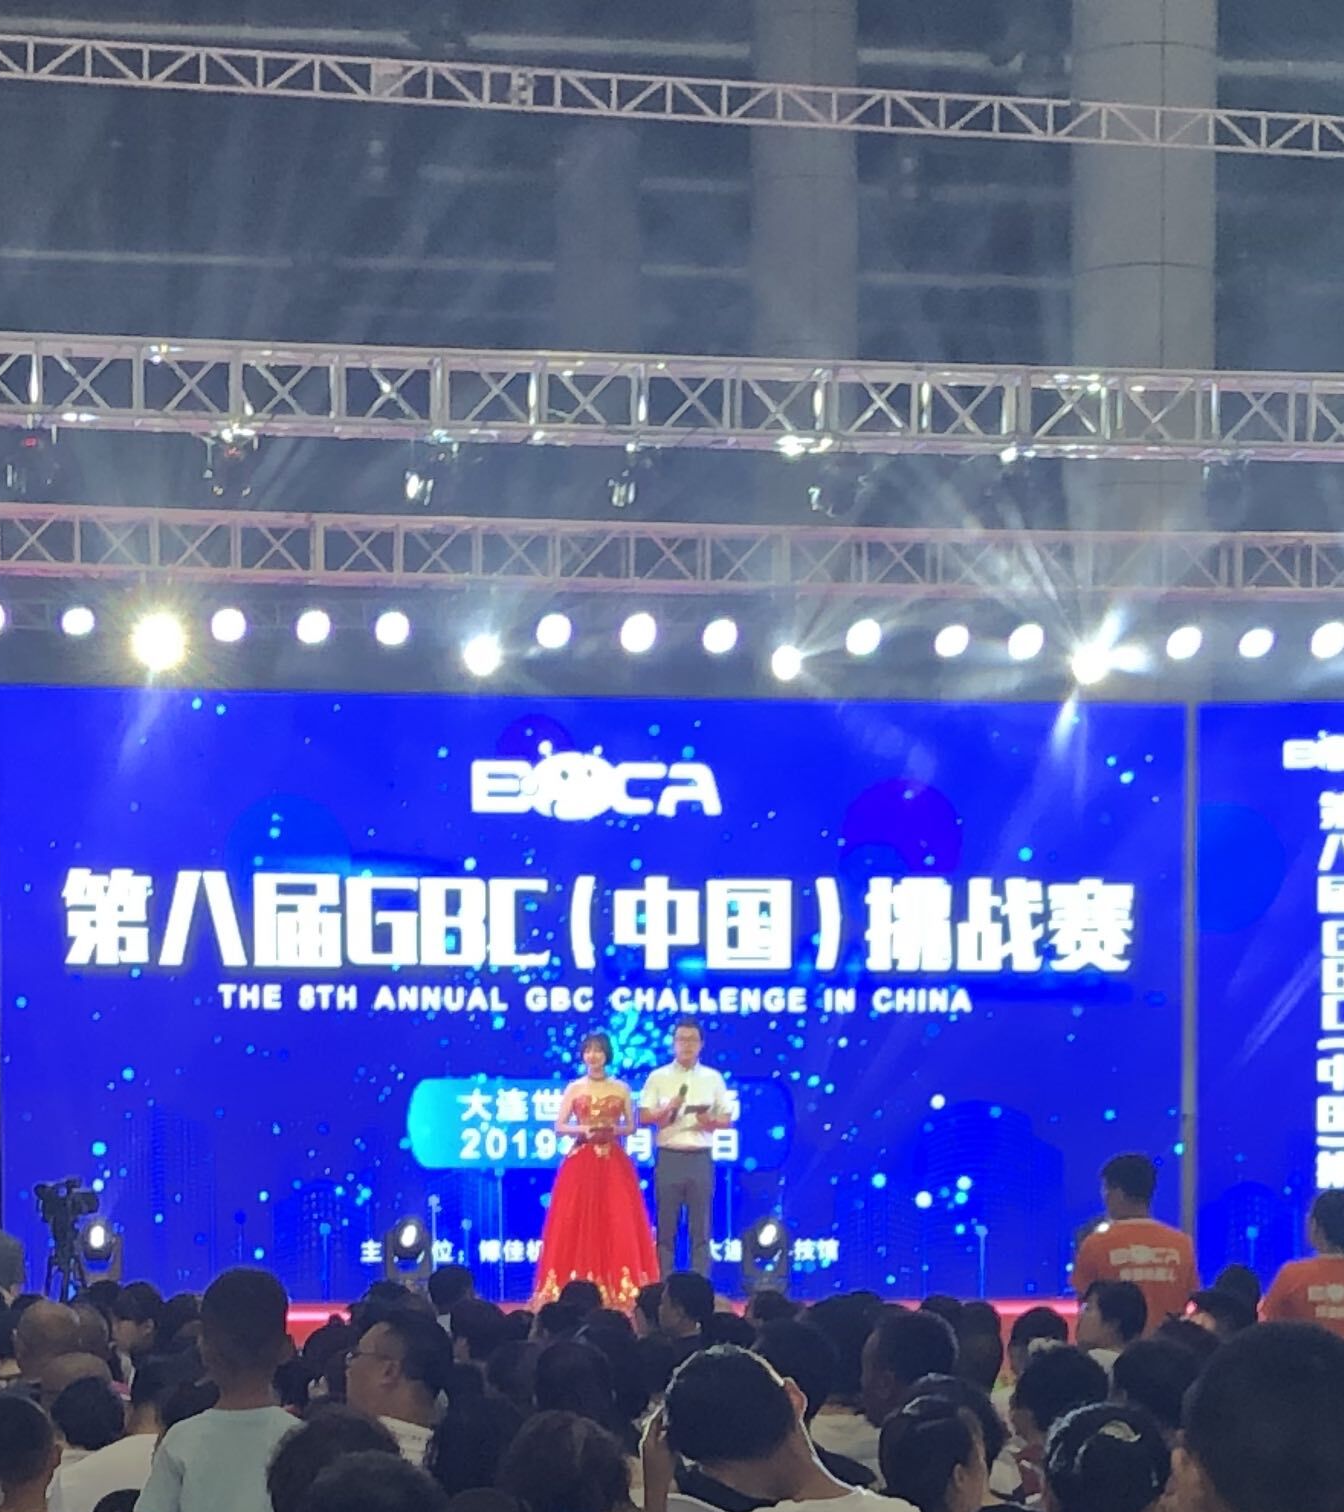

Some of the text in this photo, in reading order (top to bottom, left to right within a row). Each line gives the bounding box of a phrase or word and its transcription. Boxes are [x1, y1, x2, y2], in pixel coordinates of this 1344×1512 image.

[62, 867, 1135, 972] 第八届GBC（中国）挑战赛
[218, 983, 974, 1013] THE 8TH ANNUAL GBC CHALLENGE IN CHINA
